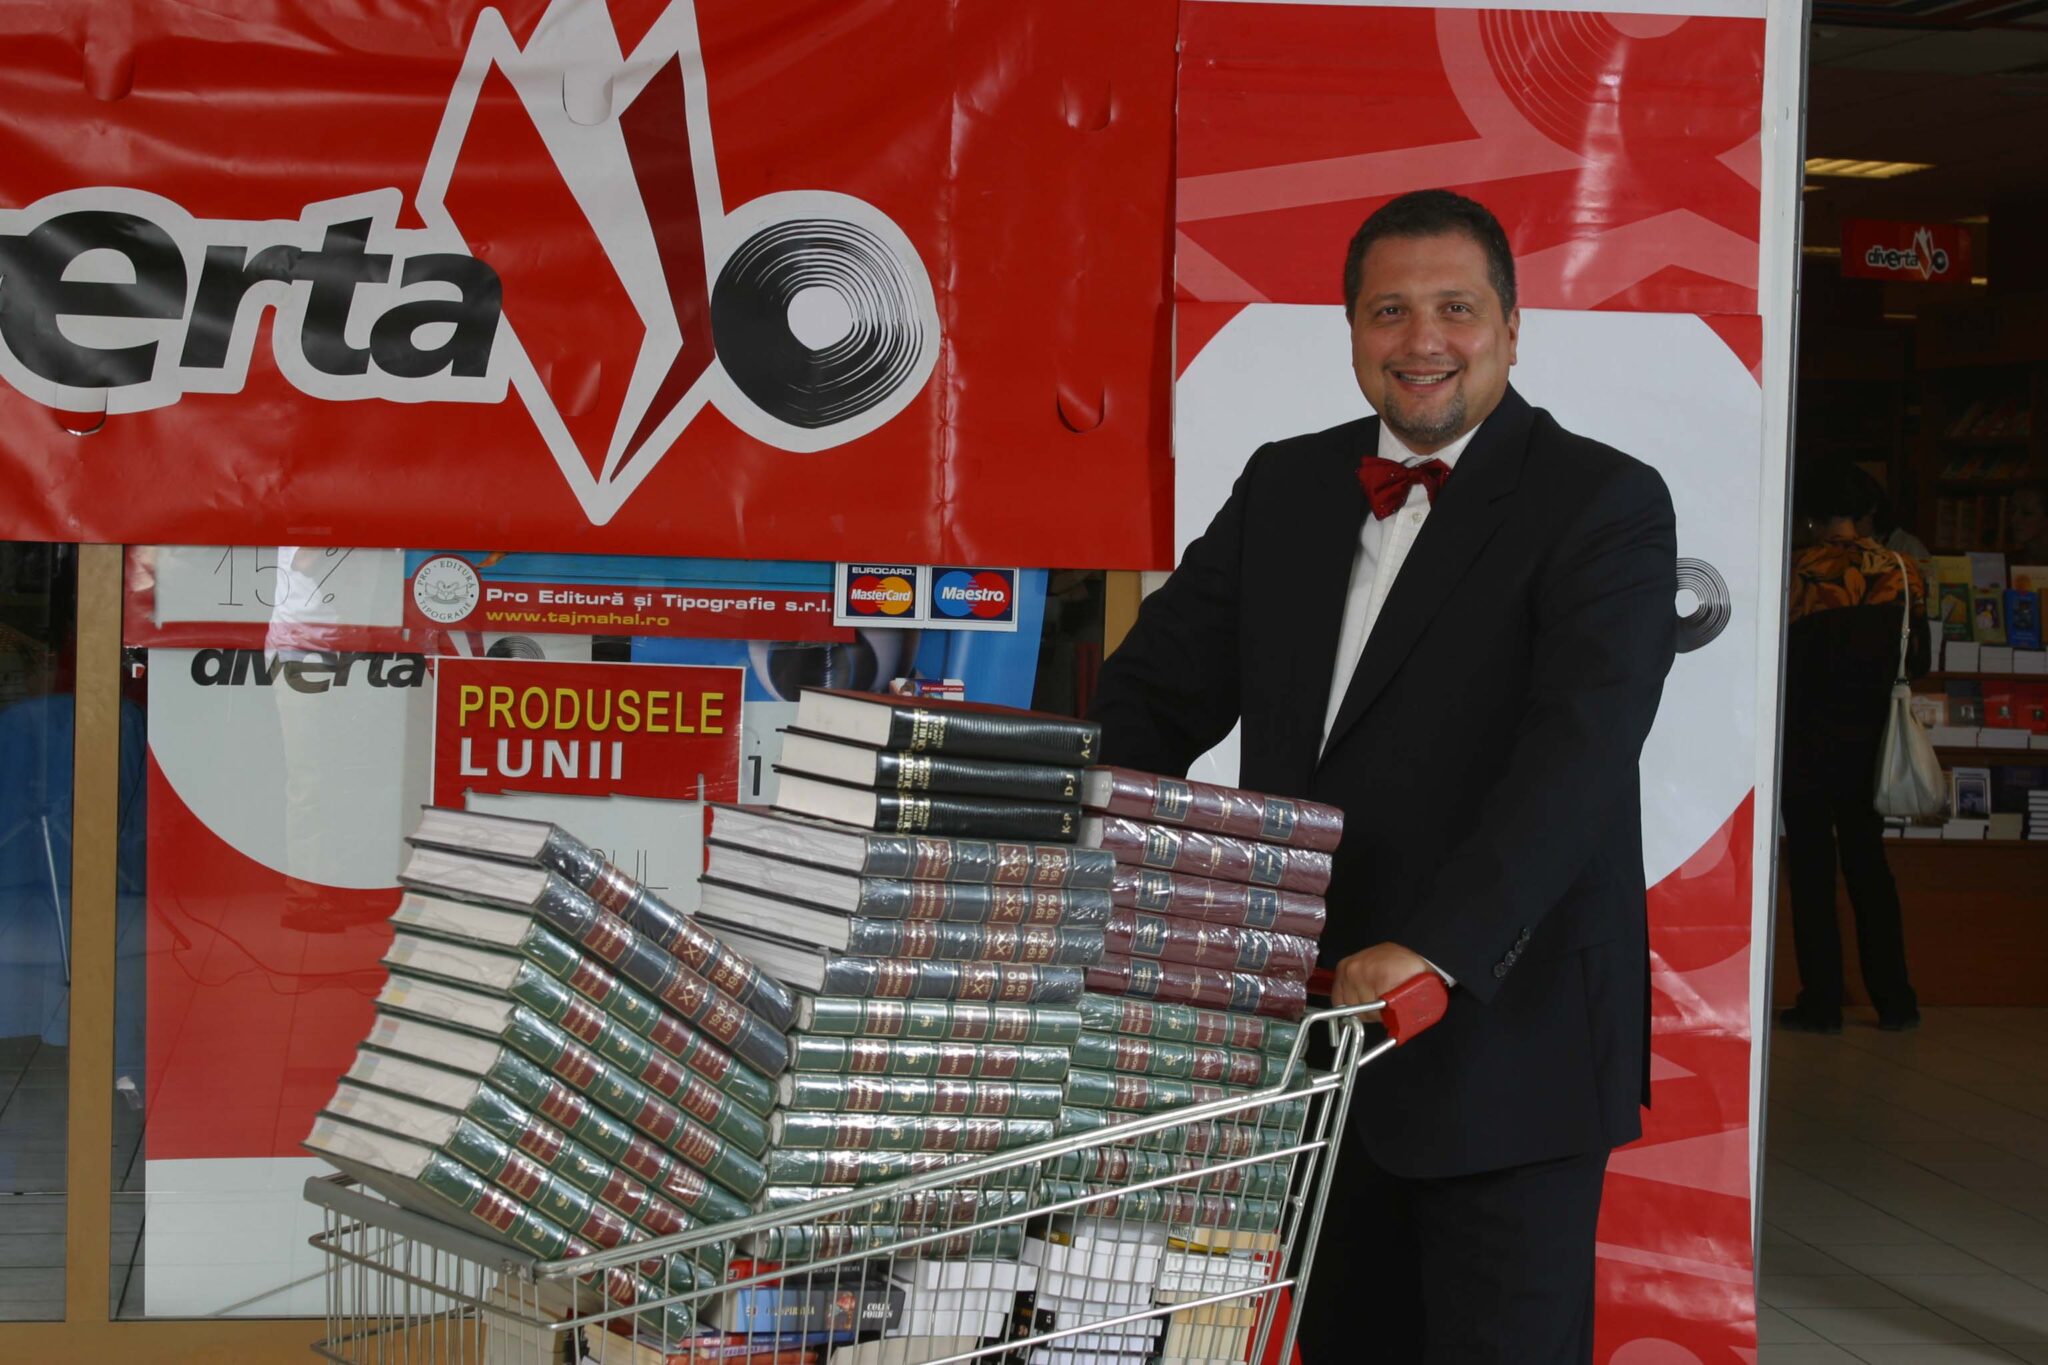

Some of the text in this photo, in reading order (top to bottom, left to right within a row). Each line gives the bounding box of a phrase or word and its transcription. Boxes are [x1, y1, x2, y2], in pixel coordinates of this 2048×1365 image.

[1867, 247, 1919, 269] diverta
[417, 567, 432, 586] PRO
[486, 588, 528, 604] Pro
[538, 589, 624, 606] Editură
[661, 592, 776, 614] Tipografie
[785, 598, 832, 613] s.r.l.
[851, 587, 912, 602] MasterCard
[941, 586, 1004, 603] Maestro
[486, 611, 670, 627] www.tajmahal.ro
[459, 685, 725, 735] PRODUSELE
[459, 736, 623, 780] LUNII
[1081, 732, 1093, 759] A-C
[1063, 772, 1076, 797] D-J
[1060, 811, 1077, 834] K-P
[1035, 893, 1047, 919] 1970
[678, 979, 698, 1006] XX
[1004, 971, 1017, 996] 1910
[1016, 972, 1029, 996] 1919
[708, 1000, 728, 1026] 1900
[719, 1006, 739, 1034] 1909
